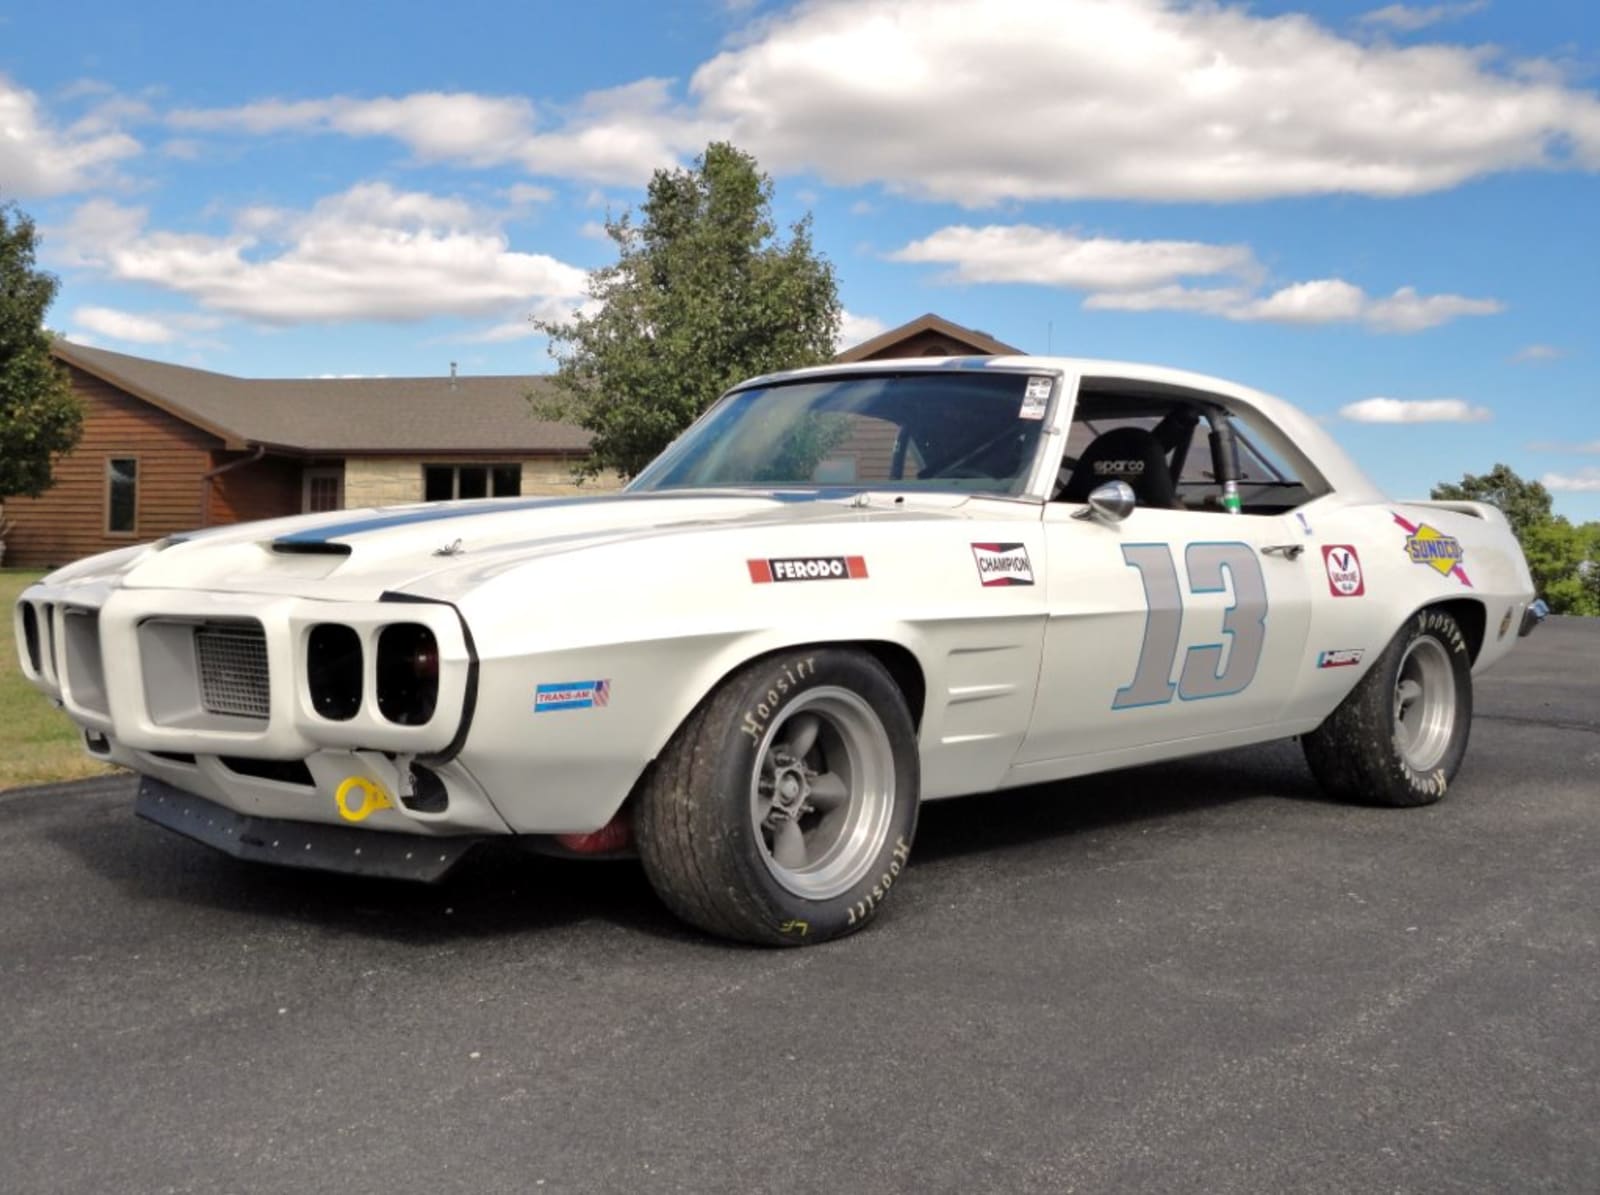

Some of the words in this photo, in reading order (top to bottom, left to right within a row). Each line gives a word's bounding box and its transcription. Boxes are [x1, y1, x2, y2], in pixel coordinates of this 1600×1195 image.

[1410, 539, 1459, 558] SUNOCO
[773, 560, 844, 579] FERODO
[979, 556, 1031, 572] CHAMPION
[1111, 541, 1268, 710] 13
